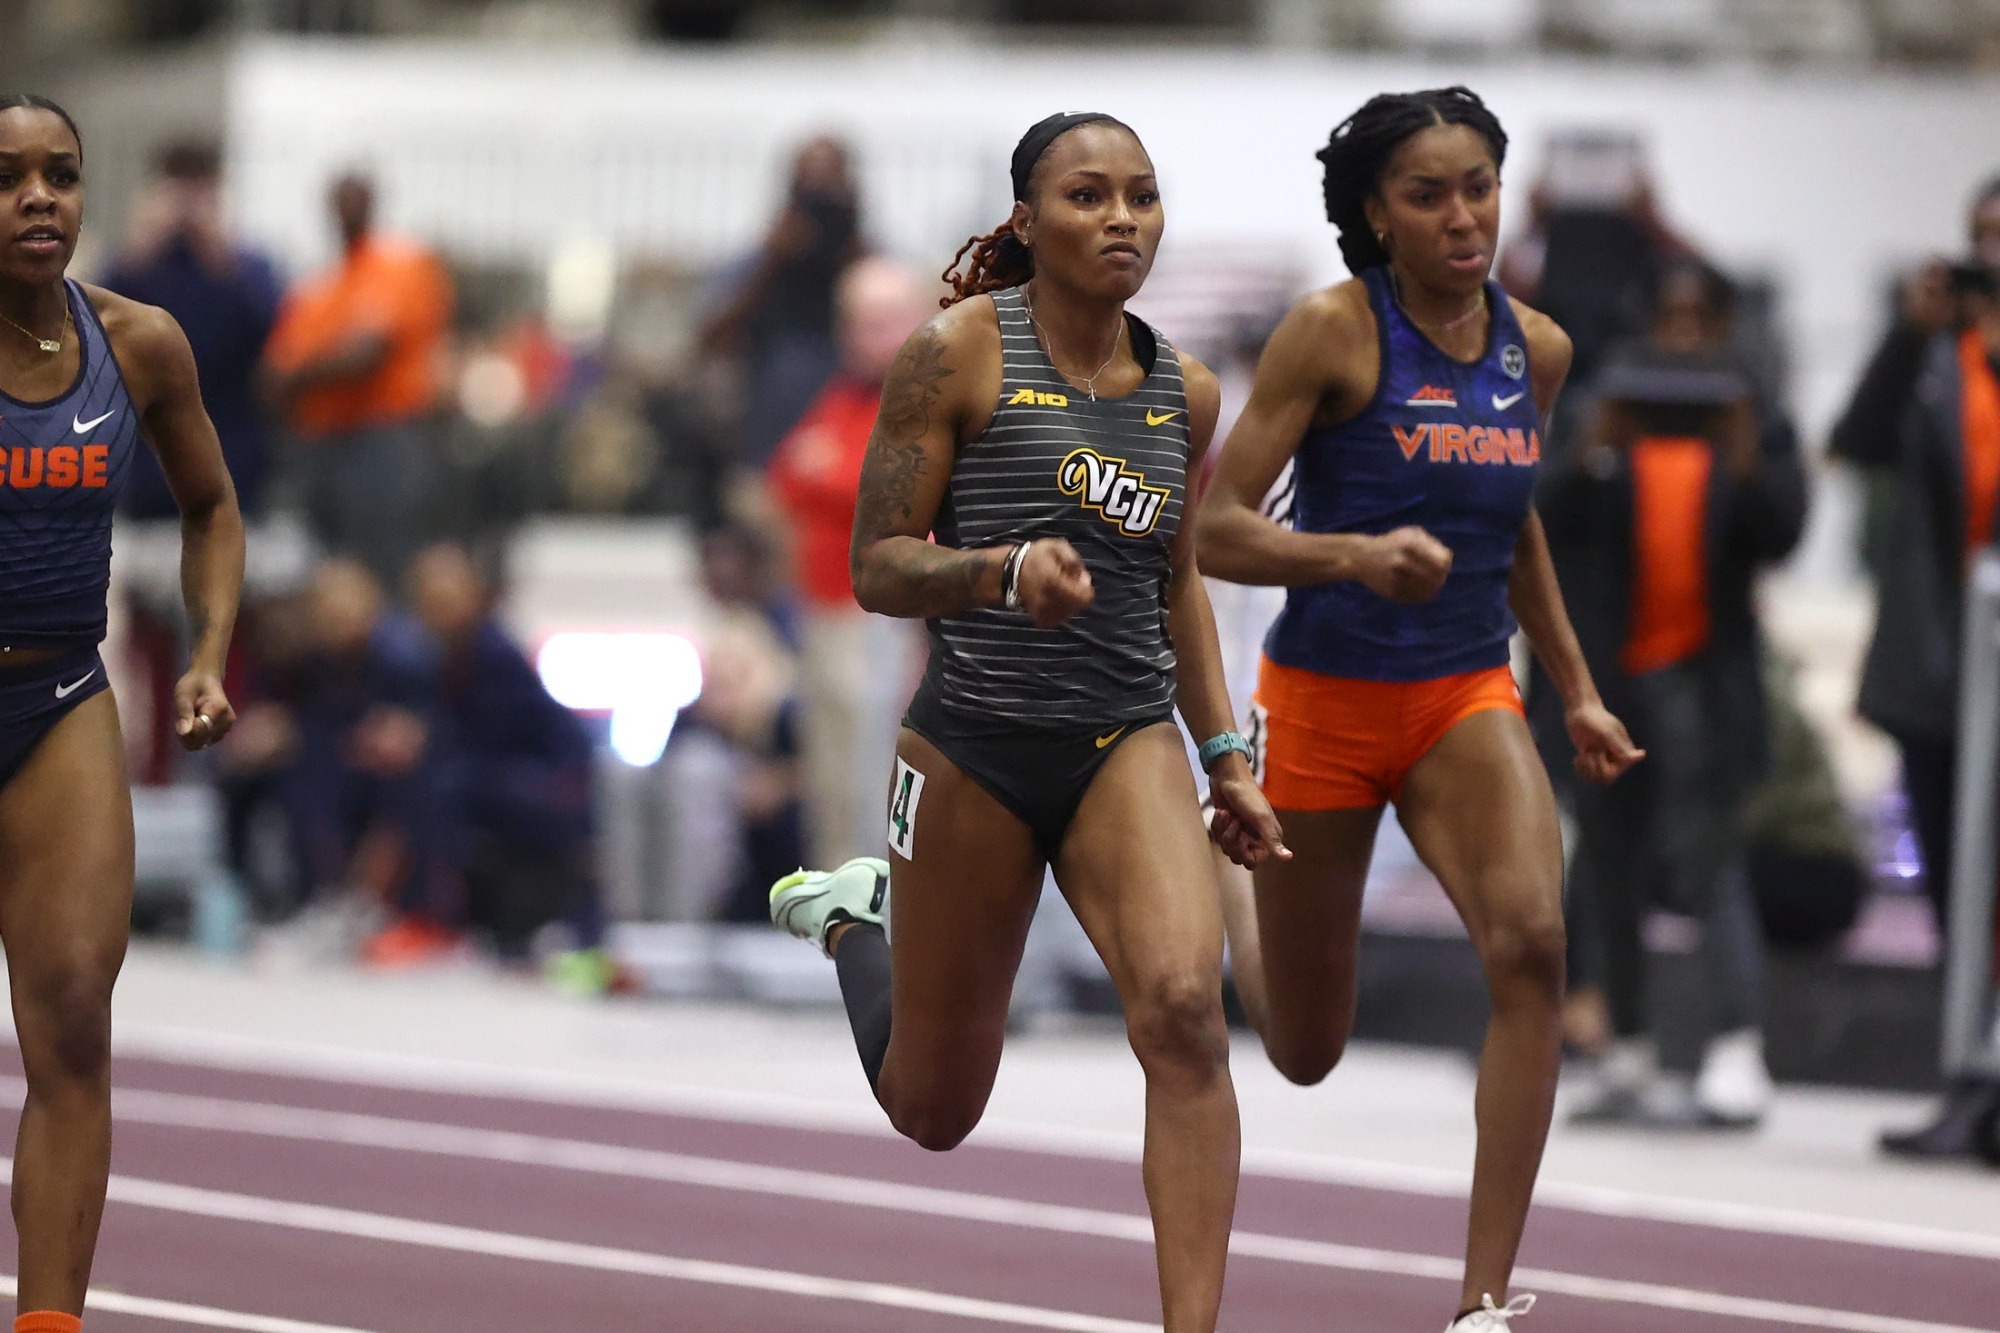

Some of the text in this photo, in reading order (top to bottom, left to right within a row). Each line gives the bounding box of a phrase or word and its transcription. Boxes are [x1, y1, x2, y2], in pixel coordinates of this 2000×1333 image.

[0, 444, 109, 489] USE
[1391, 423, 1540, 467] VIRGINIA
[1062, 451, 1166, 534] VCU
[892, 769, 915, 848] 4
